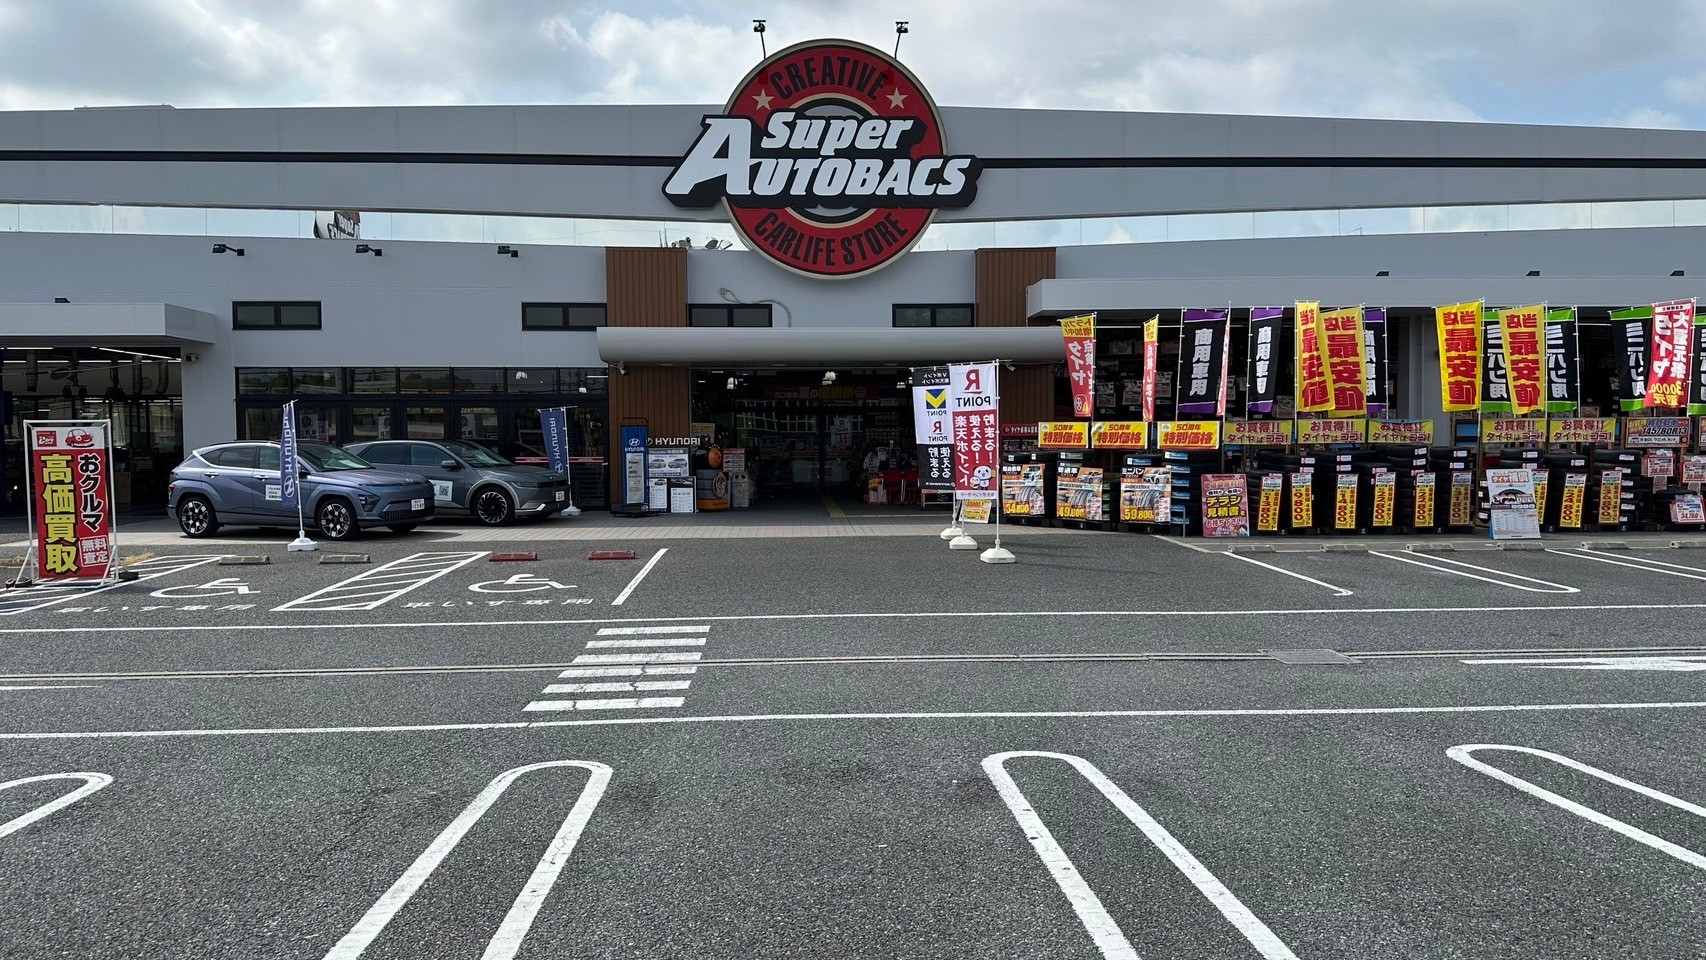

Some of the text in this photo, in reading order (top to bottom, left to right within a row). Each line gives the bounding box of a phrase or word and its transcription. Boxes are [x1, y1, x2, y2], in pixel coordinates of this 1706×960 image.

[769, 56, 888, 100] CREATIVE
[761, 112, 914, 155] Super
[665, 118, 972, 195] AUTOBACS
[754, 212, 908, 266] CARLIFE STORE
[1190, 328, 1214, 396] 商用車用
[1302, 327, 1330, 407] 最安値
[1176, 423, 1200, 431] 50周年
[1642, 427, 1687, 435] 145/80R13
[655, 437, 700, 445] HYUNDAI
[1043, 432, 1083, 443] 特別価格
[1097, 432, 1141, 443] 特別価格
[1163, 432, 1212, 444] 特別価格
[78, 453, 103, 532] おクルマ
[1207, 496, 1241, 506] チラシ
[41, 454, 78, 573] 高価買取
[81, 538, 107, 552] 無料
[83, 551, 109, 564] 査定
